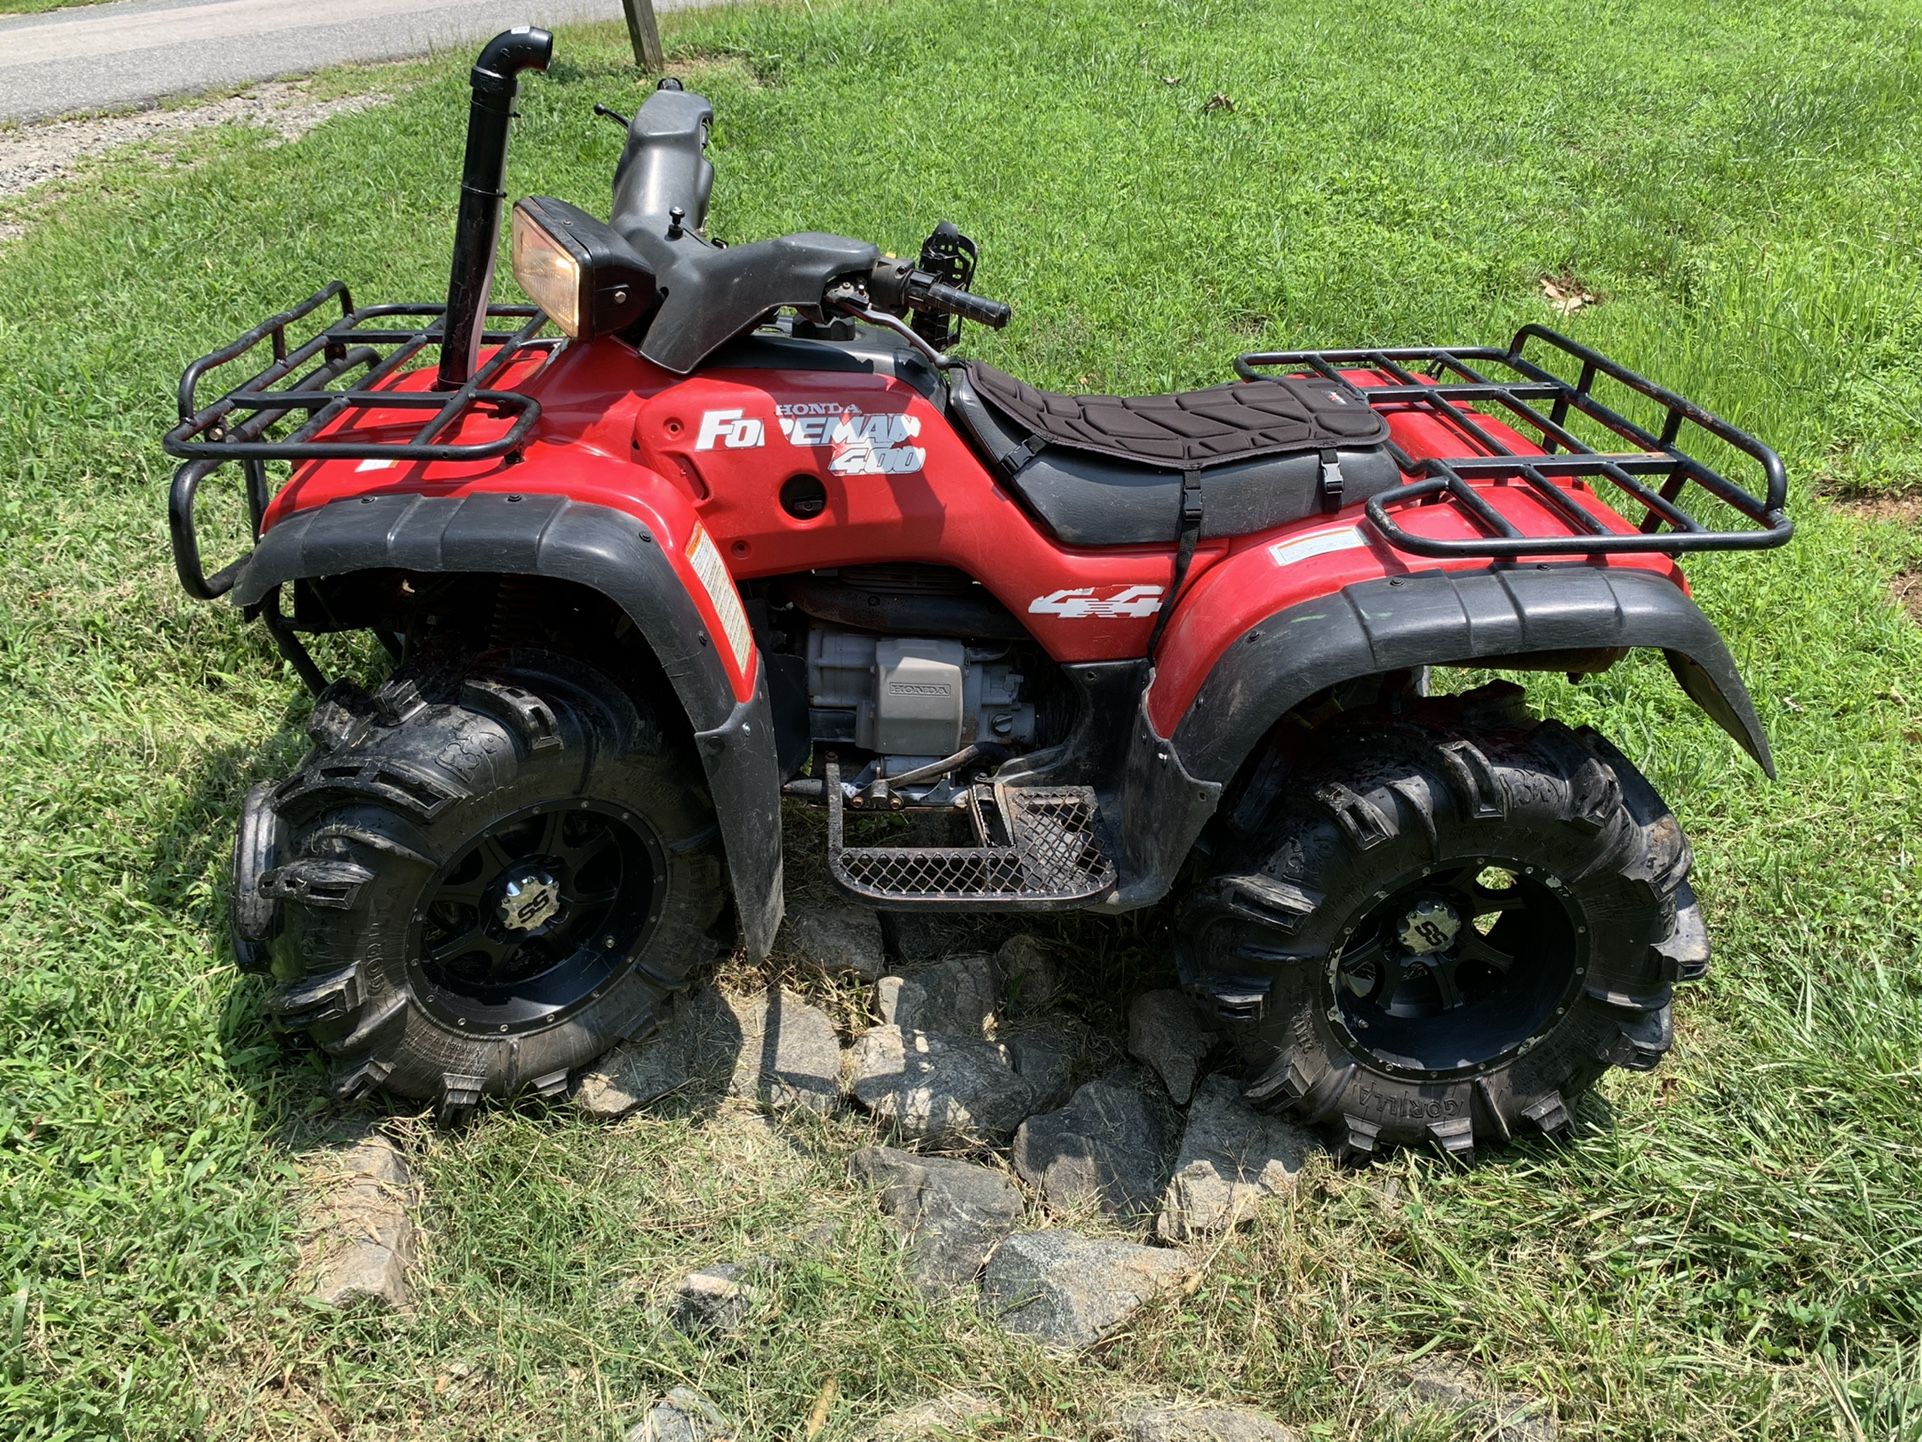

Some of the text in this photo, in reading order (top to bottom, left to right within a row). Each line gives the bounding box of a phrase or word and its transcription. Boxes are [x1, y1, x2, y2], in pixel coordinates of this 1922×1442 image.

[775, 402, 862, 416] HONDA
[828, 446, 926, 476] 400
[891, 684, 949, 695] HONDA
[1358, 1085, 1460, 1119] GORILLA
